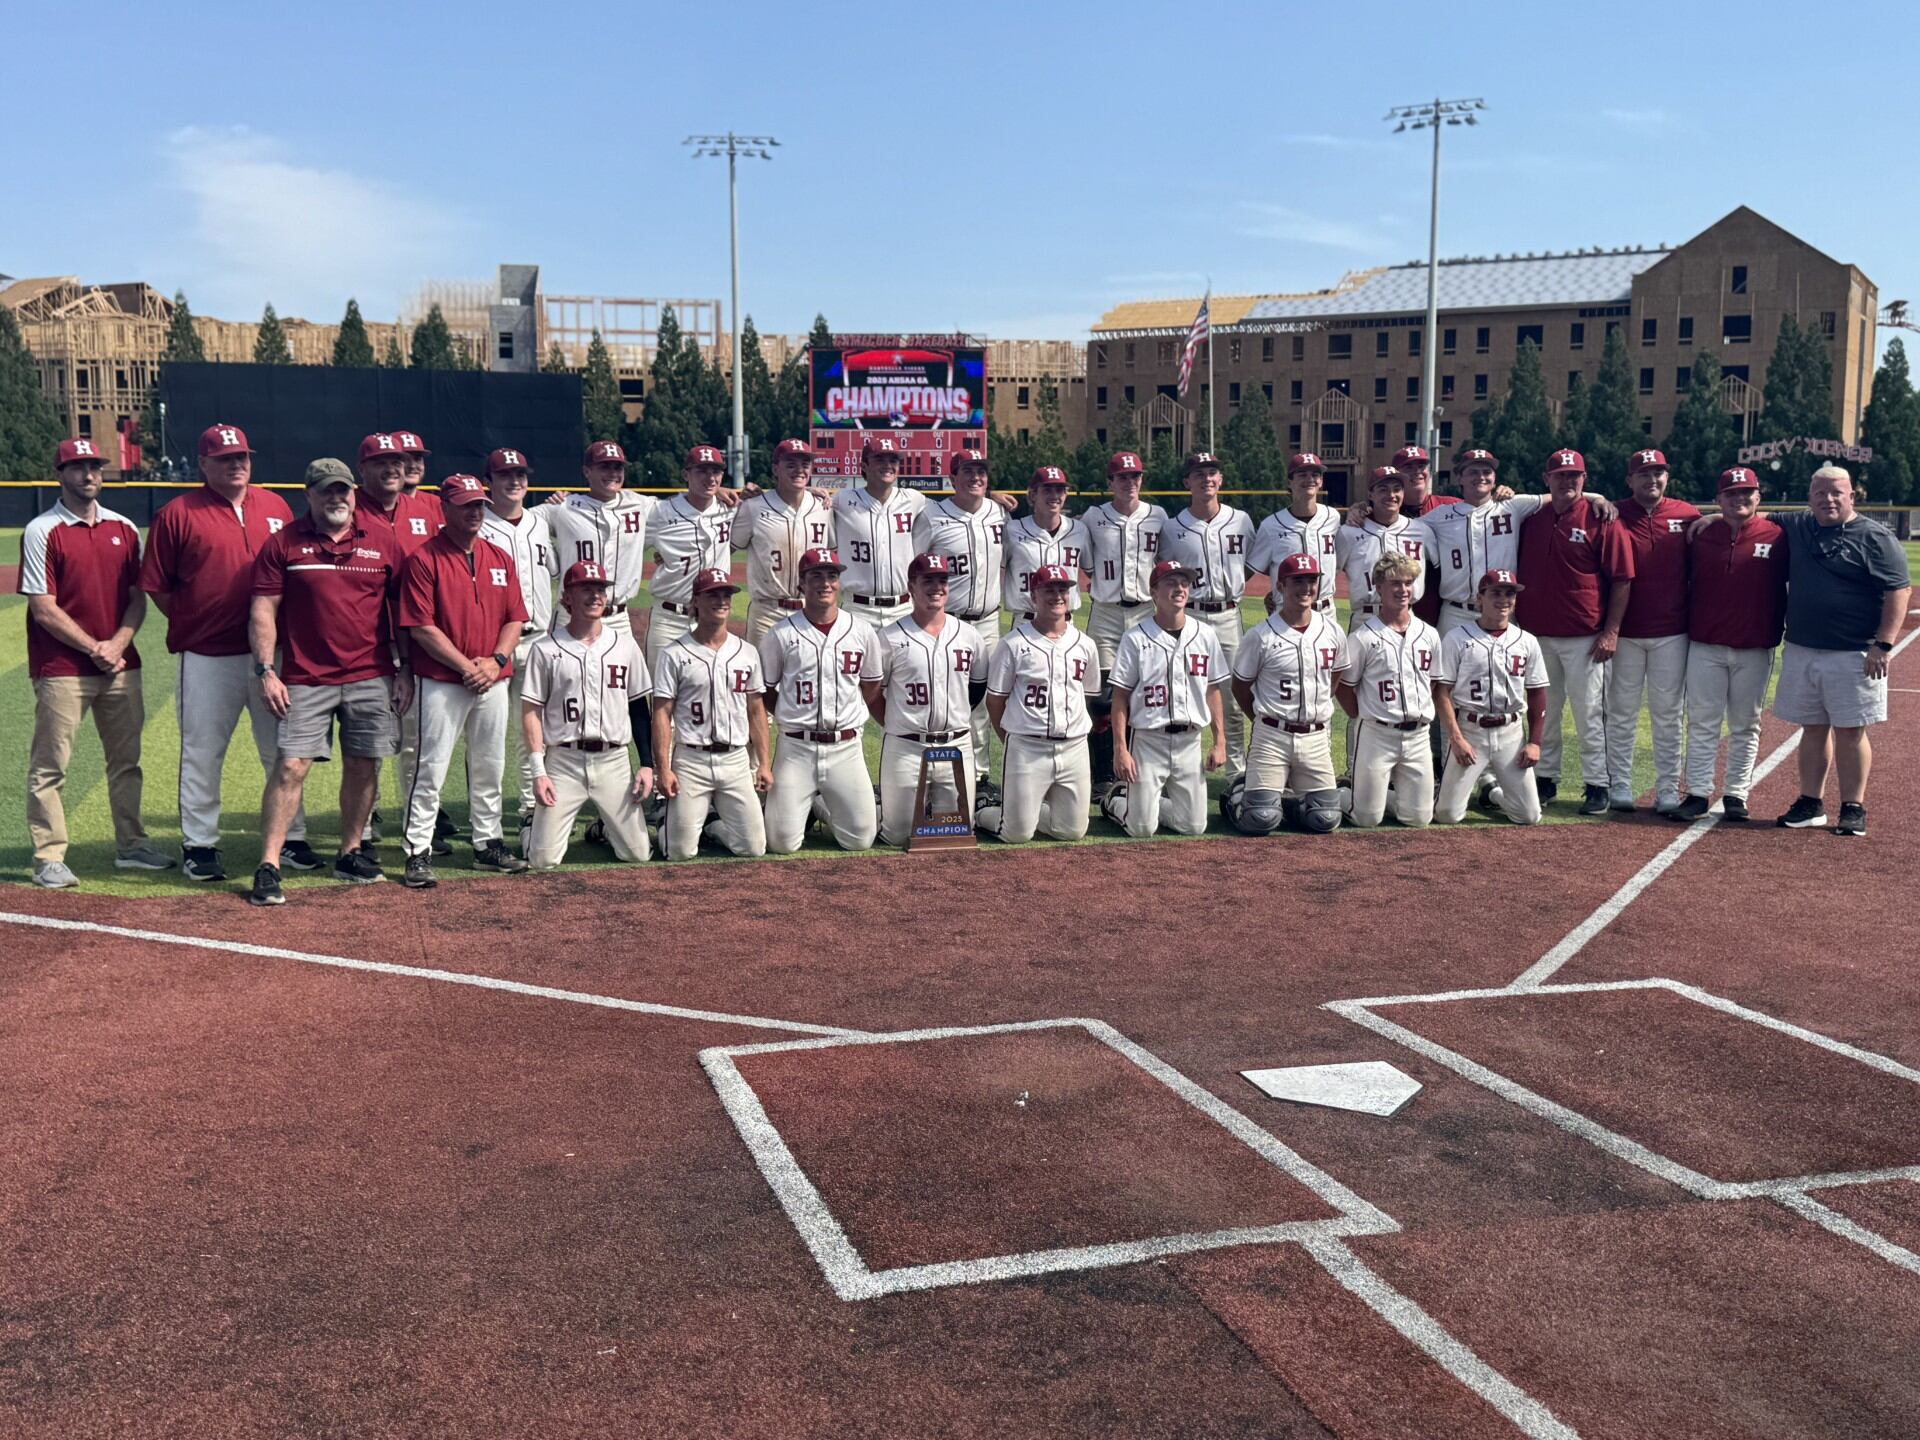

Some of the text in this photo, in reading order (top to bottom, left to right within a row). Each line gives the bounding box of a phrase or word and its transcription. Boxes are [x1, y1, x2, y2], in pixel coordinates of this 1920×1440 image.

[827, 386, 968, 423] CHAMPIONS
[220, 430, 239, 445] H
[378, 435, 395, 449] H
[401, 433, 417, 448] H
[791, 440, 804, 451] H
[880, 439, 894, 450] H
[900, 437, 907, 448] 0
[935, 437, 942, 448] 0
[74, 440, 93, 455] H
[604, 444, 621, 458] H
[700, 448, 716, 462] H
[970, 450, 982, 460] H
[1405, 447, 1420, 457] H
[1473, 449, 1486, 458] H
[504, 451, 519, 464] H
[1121, 456, 1135, 468] H
[1198, 453, 1212, 462] H
[1302, 453, 1316, 464] H
[1561, 454, 1575, 465] H
[1641, 451, 1656, 463] H
[1047, 468, 1061, 480] H
[1385, 466, 1396, 475] H
[1731, 470, 1747, 482] H
[463, 478, 479, 490] H
[409, 518, 427, 535] H
[623, 512, 640, 533] H
[893, 513, 912, 533] H
[1490, 514, 1513, 536] H
[1667, 519, 1683, 533] H
[718, 522, 730, 543] H
[811, 522, 826, 543] H
[1569, 528, 1587, 543] H
[576, 540, 594, 561] 10
[1144, 532, 1158, 552] H
[1226, 535, 1244, 554] H
[1322, 535, 1335, 554] H
[817, 550, 833, 563] H
[850, 541, 871, 563] 33
[1064, 547, 1080, 567] H
[1403, 541, 1422, 561] H
[1451, 549, 1463, 569] 8
[1752, 543, 1772, 559] H
[681, 557, 691, 576] 7
[771, 550, 782, 571] 3
[928, 556, 943, 568] H
[946, 555, 969, 575] 32
[1168, 560, 1181, 569] H
[1297, 557, 1311, 569] H
[490, 568, 508, 586] H
[584, 565, 600, 578] H
[711, 571, 728, 583] H
[1048, 567, 1063, 579] H
[1104, 560, 1115, 580] 11
[1497, 570, 1511, 583] H
[841, 651, 864, 674] H
[953, 650, 972, 671] H
[1189, 654, 1209, 677] H
[1319, 648, 1337, 670] H
[1419, 650, 1432, 672] H
[1510, 655, 1527, 677] H
[607, 665, 628, 690] H
[1073, 658, 1087, 682] H
[733, 669, 751, 693] H
[796, 681, 814, 704] 13
[904, 682, 929, 705] 39
[1024, 685, 1048, 708] 26
[1144, 685, 1168, 707] 23
[1280, 680, 1292, 700] 5
[1378, 680, 1396, 702] 15
[1470, 681, 1484, 700] 2
[563, 698, 581, 722] 16
[691, 702, 705, 725] 9
[930, 750, 956, 758] STATE
[941, 815, 963, 823] 2025
[916, 826, 968, 835] CHAMPION
